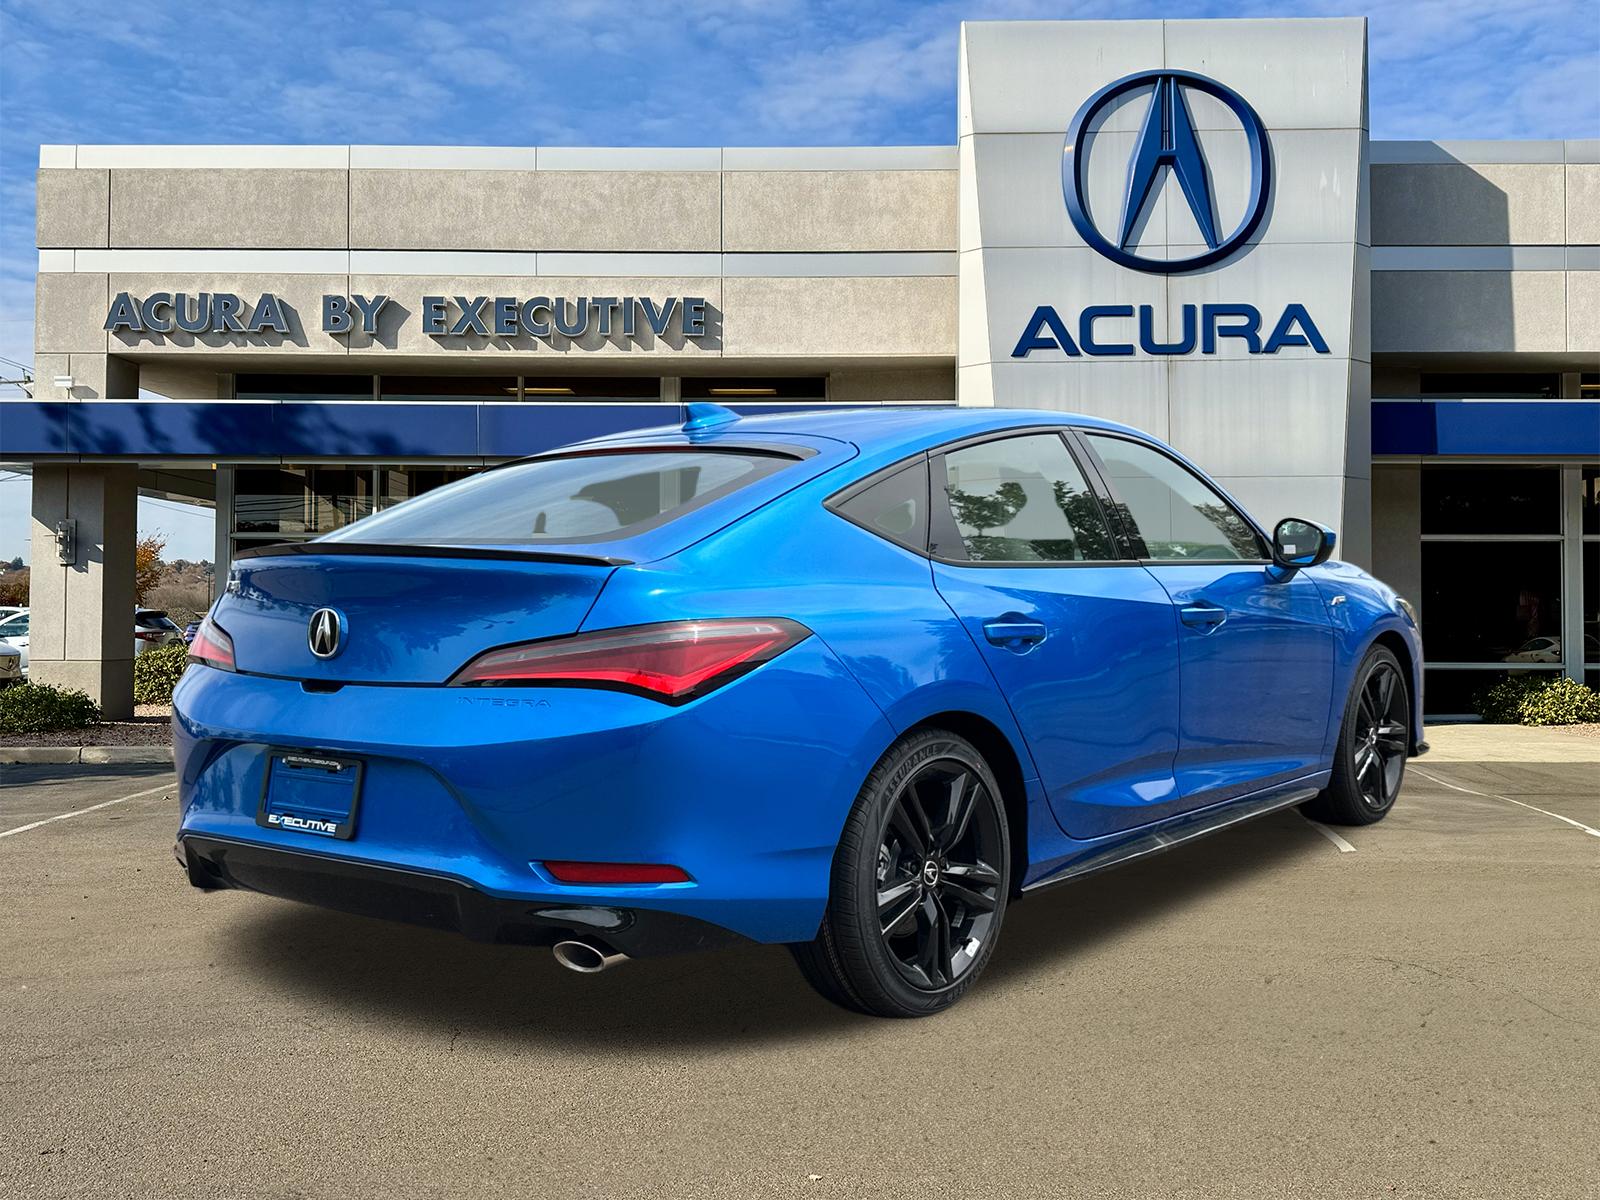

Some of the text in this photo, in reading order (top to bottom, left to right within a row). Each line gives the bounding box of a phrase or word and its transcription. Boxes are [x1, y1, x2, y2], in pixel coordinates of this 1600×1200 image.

[104, 292, 706, 338] ACURA BY EXECUTIVE
[1011, 303, 1332, 357] ACURA
[457, 697, 552, 708] INTEGRA
[268, 814, 336, 832] EXECUTIVE
